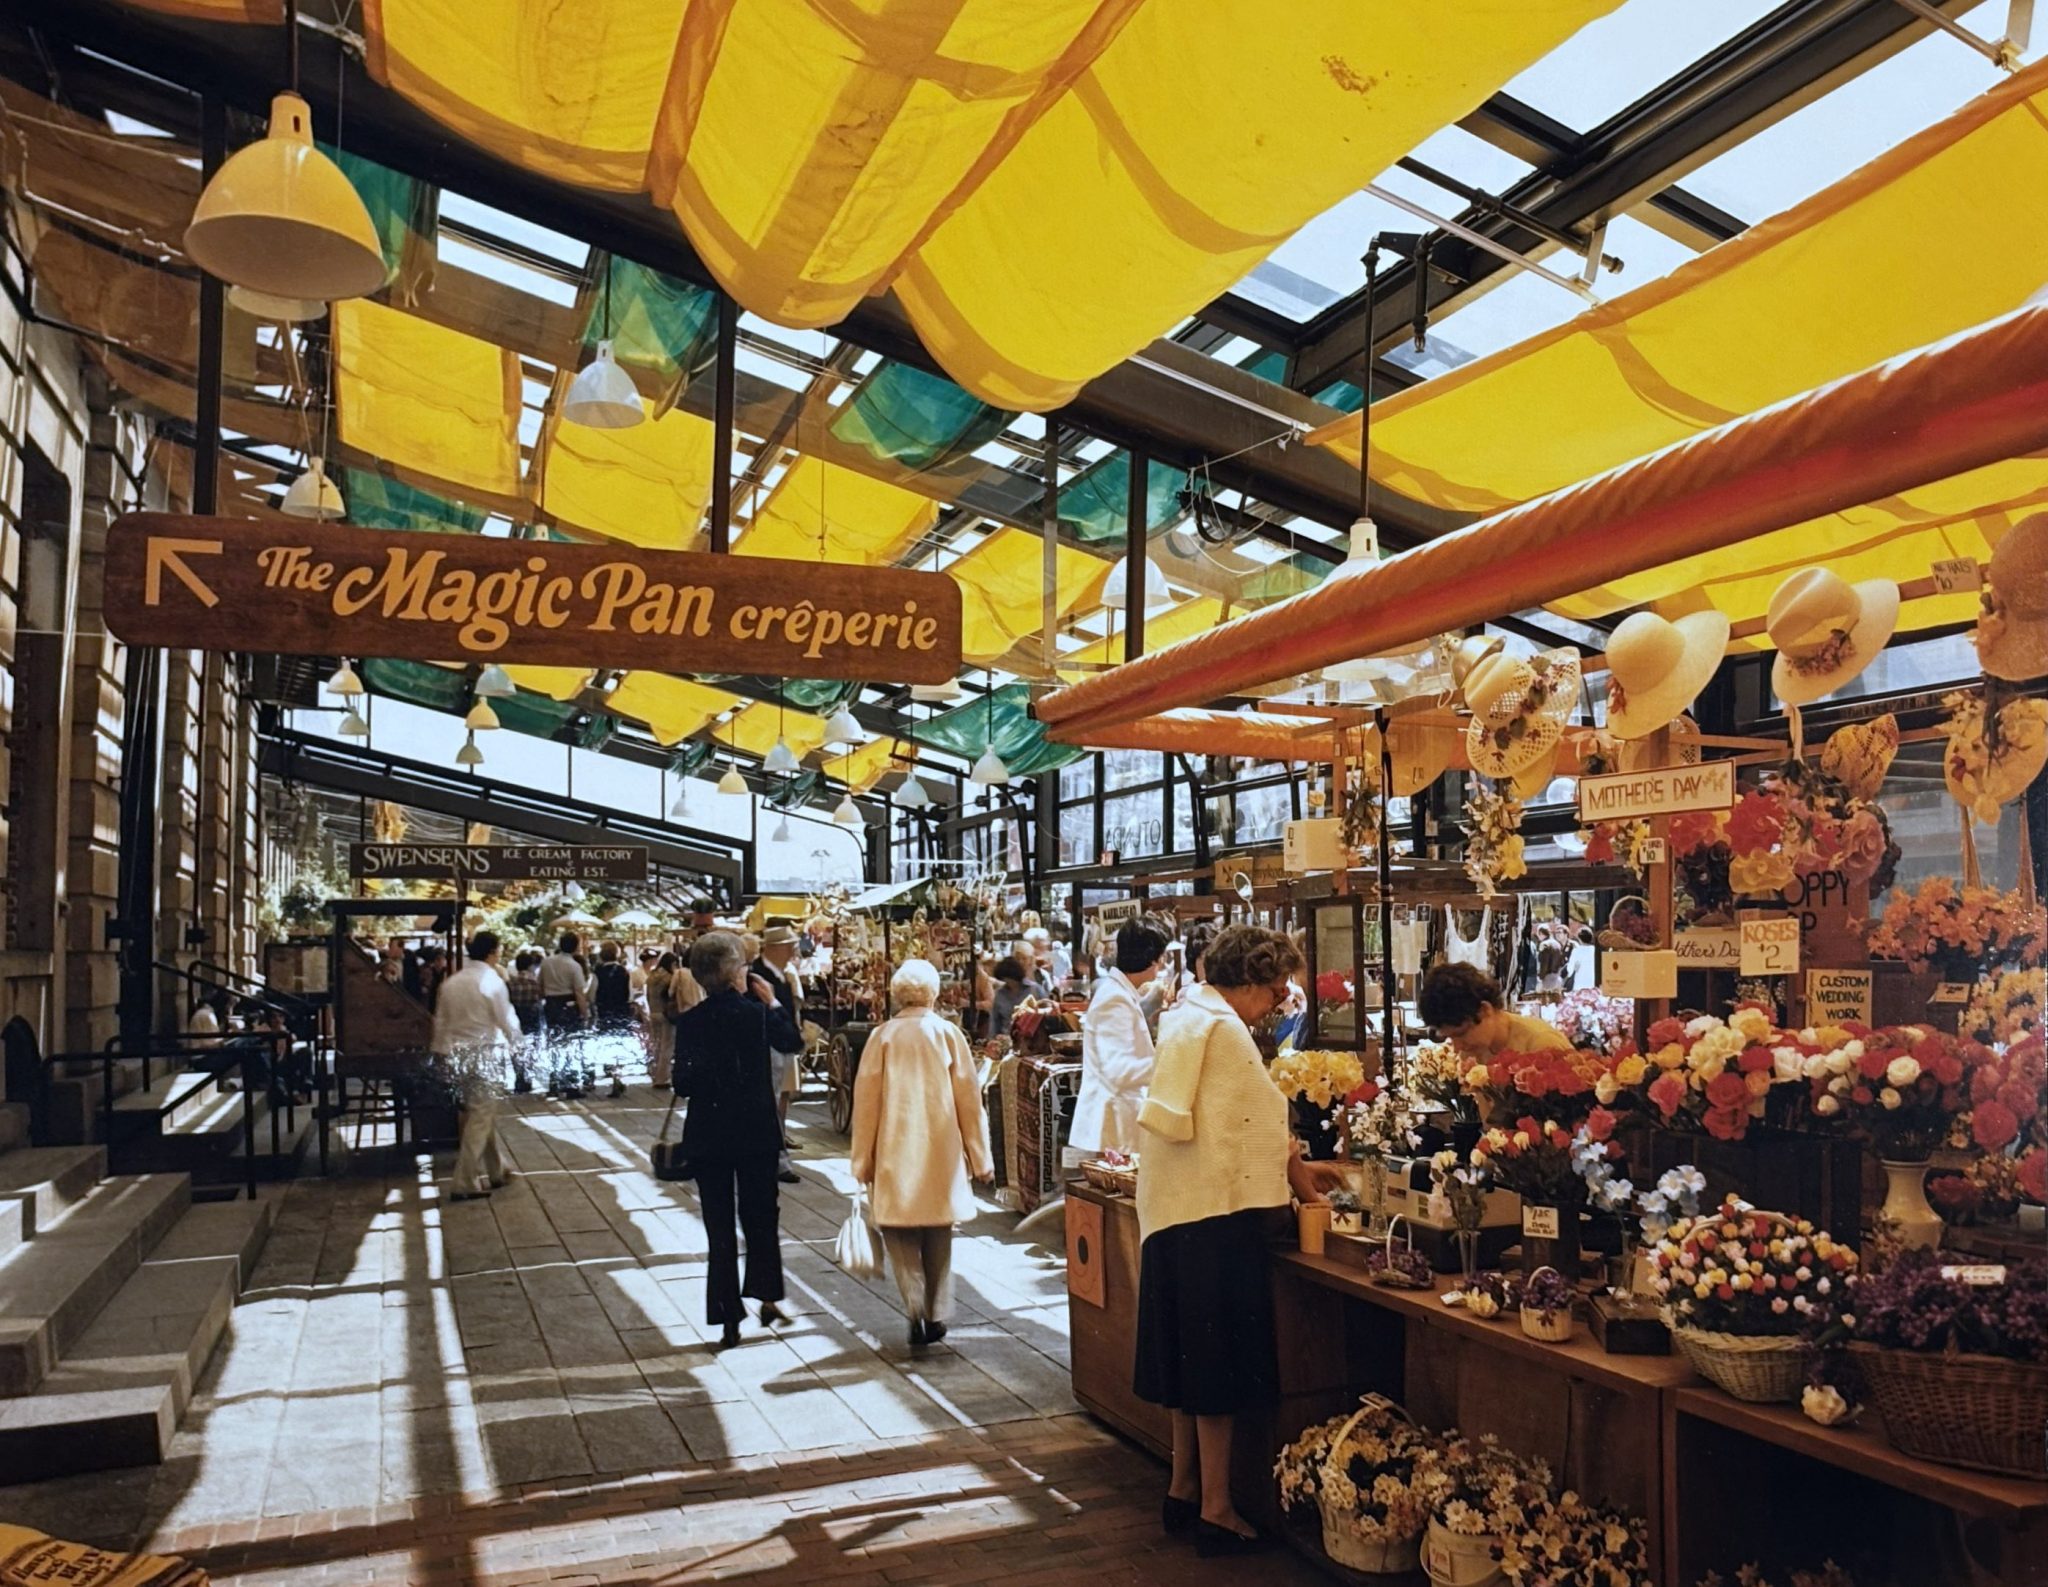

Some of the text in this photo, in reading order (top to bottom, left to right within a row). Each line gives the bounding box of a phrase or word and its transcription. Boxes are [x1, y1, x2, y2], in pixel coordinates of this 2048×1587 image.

[256, 546, 937, 658] The Magic Pan crêperie
[1588, 775, 1701, 810] MOTHER'S DAY
[503, 848, 521, 859] ICE
[528, 848, 571, 859] CREAM
[581, 849, 633, 860] FACTORY
[530, 866, 609, 877] EATING EST.
[1742, 922, 1798, 943] ROSES
[1674, 940, 1715, 958] other's
[1819, 975, 1869, 987] CUSTOM
[1816, 990, 1865, 1003] WEDDING
[1825, 1008, 1862, 1020] WORK
